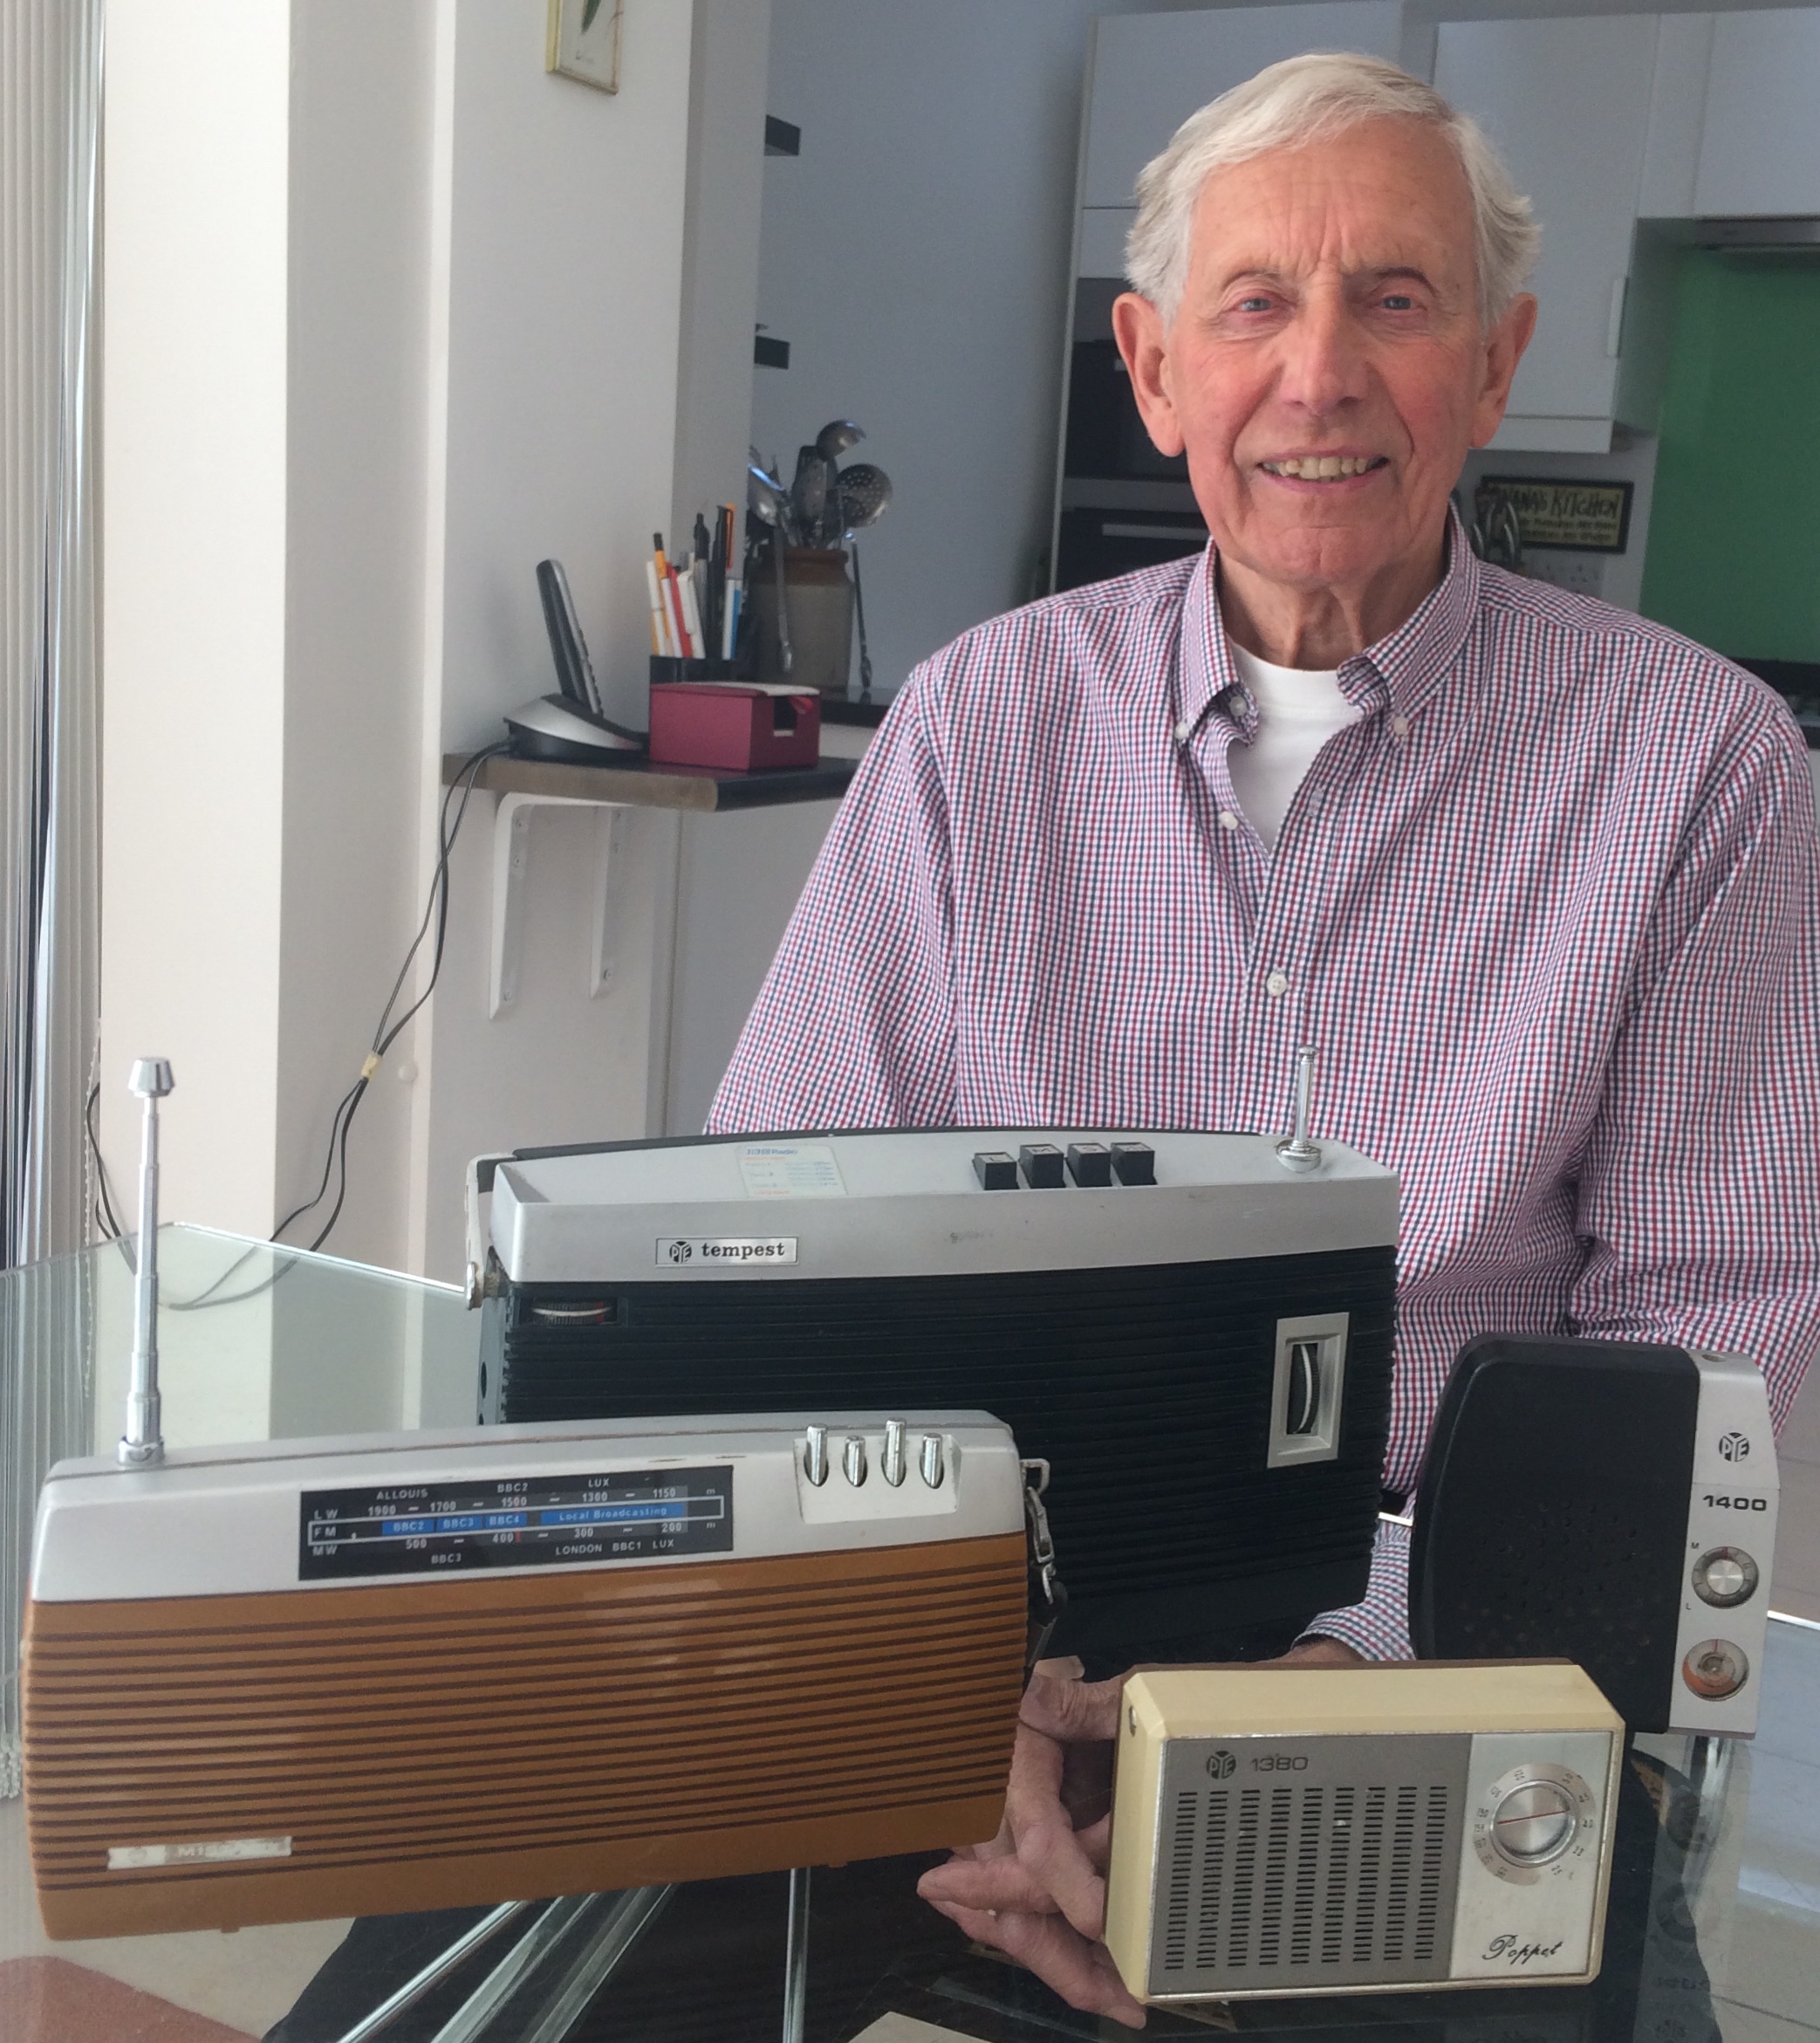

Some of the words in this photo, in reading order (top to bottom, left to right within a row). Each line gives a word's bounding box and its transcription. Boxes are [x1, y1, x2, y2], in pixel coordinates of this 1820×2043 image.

[701, 1242, 785, 1260] tempest
[497, 1483, 529, 1493] BBC2
[587, 1477, 610, 1488] LUX
[367, 1505, 397, 1517] 1900
[430, 1501, 456, 1512] 1700
[502, 1497, 527, 1507] 1500
[582, 1491, 608, 1503] 1300
[653, 1488, 676, 1498] 1150
[376, 1488, 428, 1500] ALLOUIS
[1702, 1494, 1768, 1512] 1400
[393, 1520, 424, 1533] BBC2
[443, 1518, 475, 1529] BBC3
[489, 1514, 520, 1525] BBC4
[559, 1512, 590, 1522] Local
[593, 1506, 668, 1520] Broadcasting
[406, 1539, 428, 1550] 500
[492, 1533, 514, 1544] 400
[574, 1528, 594, 1539] 300
[661, 1522, 682, 1533] 200
[431, 1553, 462, 1565] BBC3
[555, 1544, 603, 1556] LONDON
[612, 1540, 642, 1553] BBC1
[653, 1539, 674, 1549] LUX
[1251, 1756, 1309, 1772] 1380
[1482, 1934, 1563, 1964] Poppet
